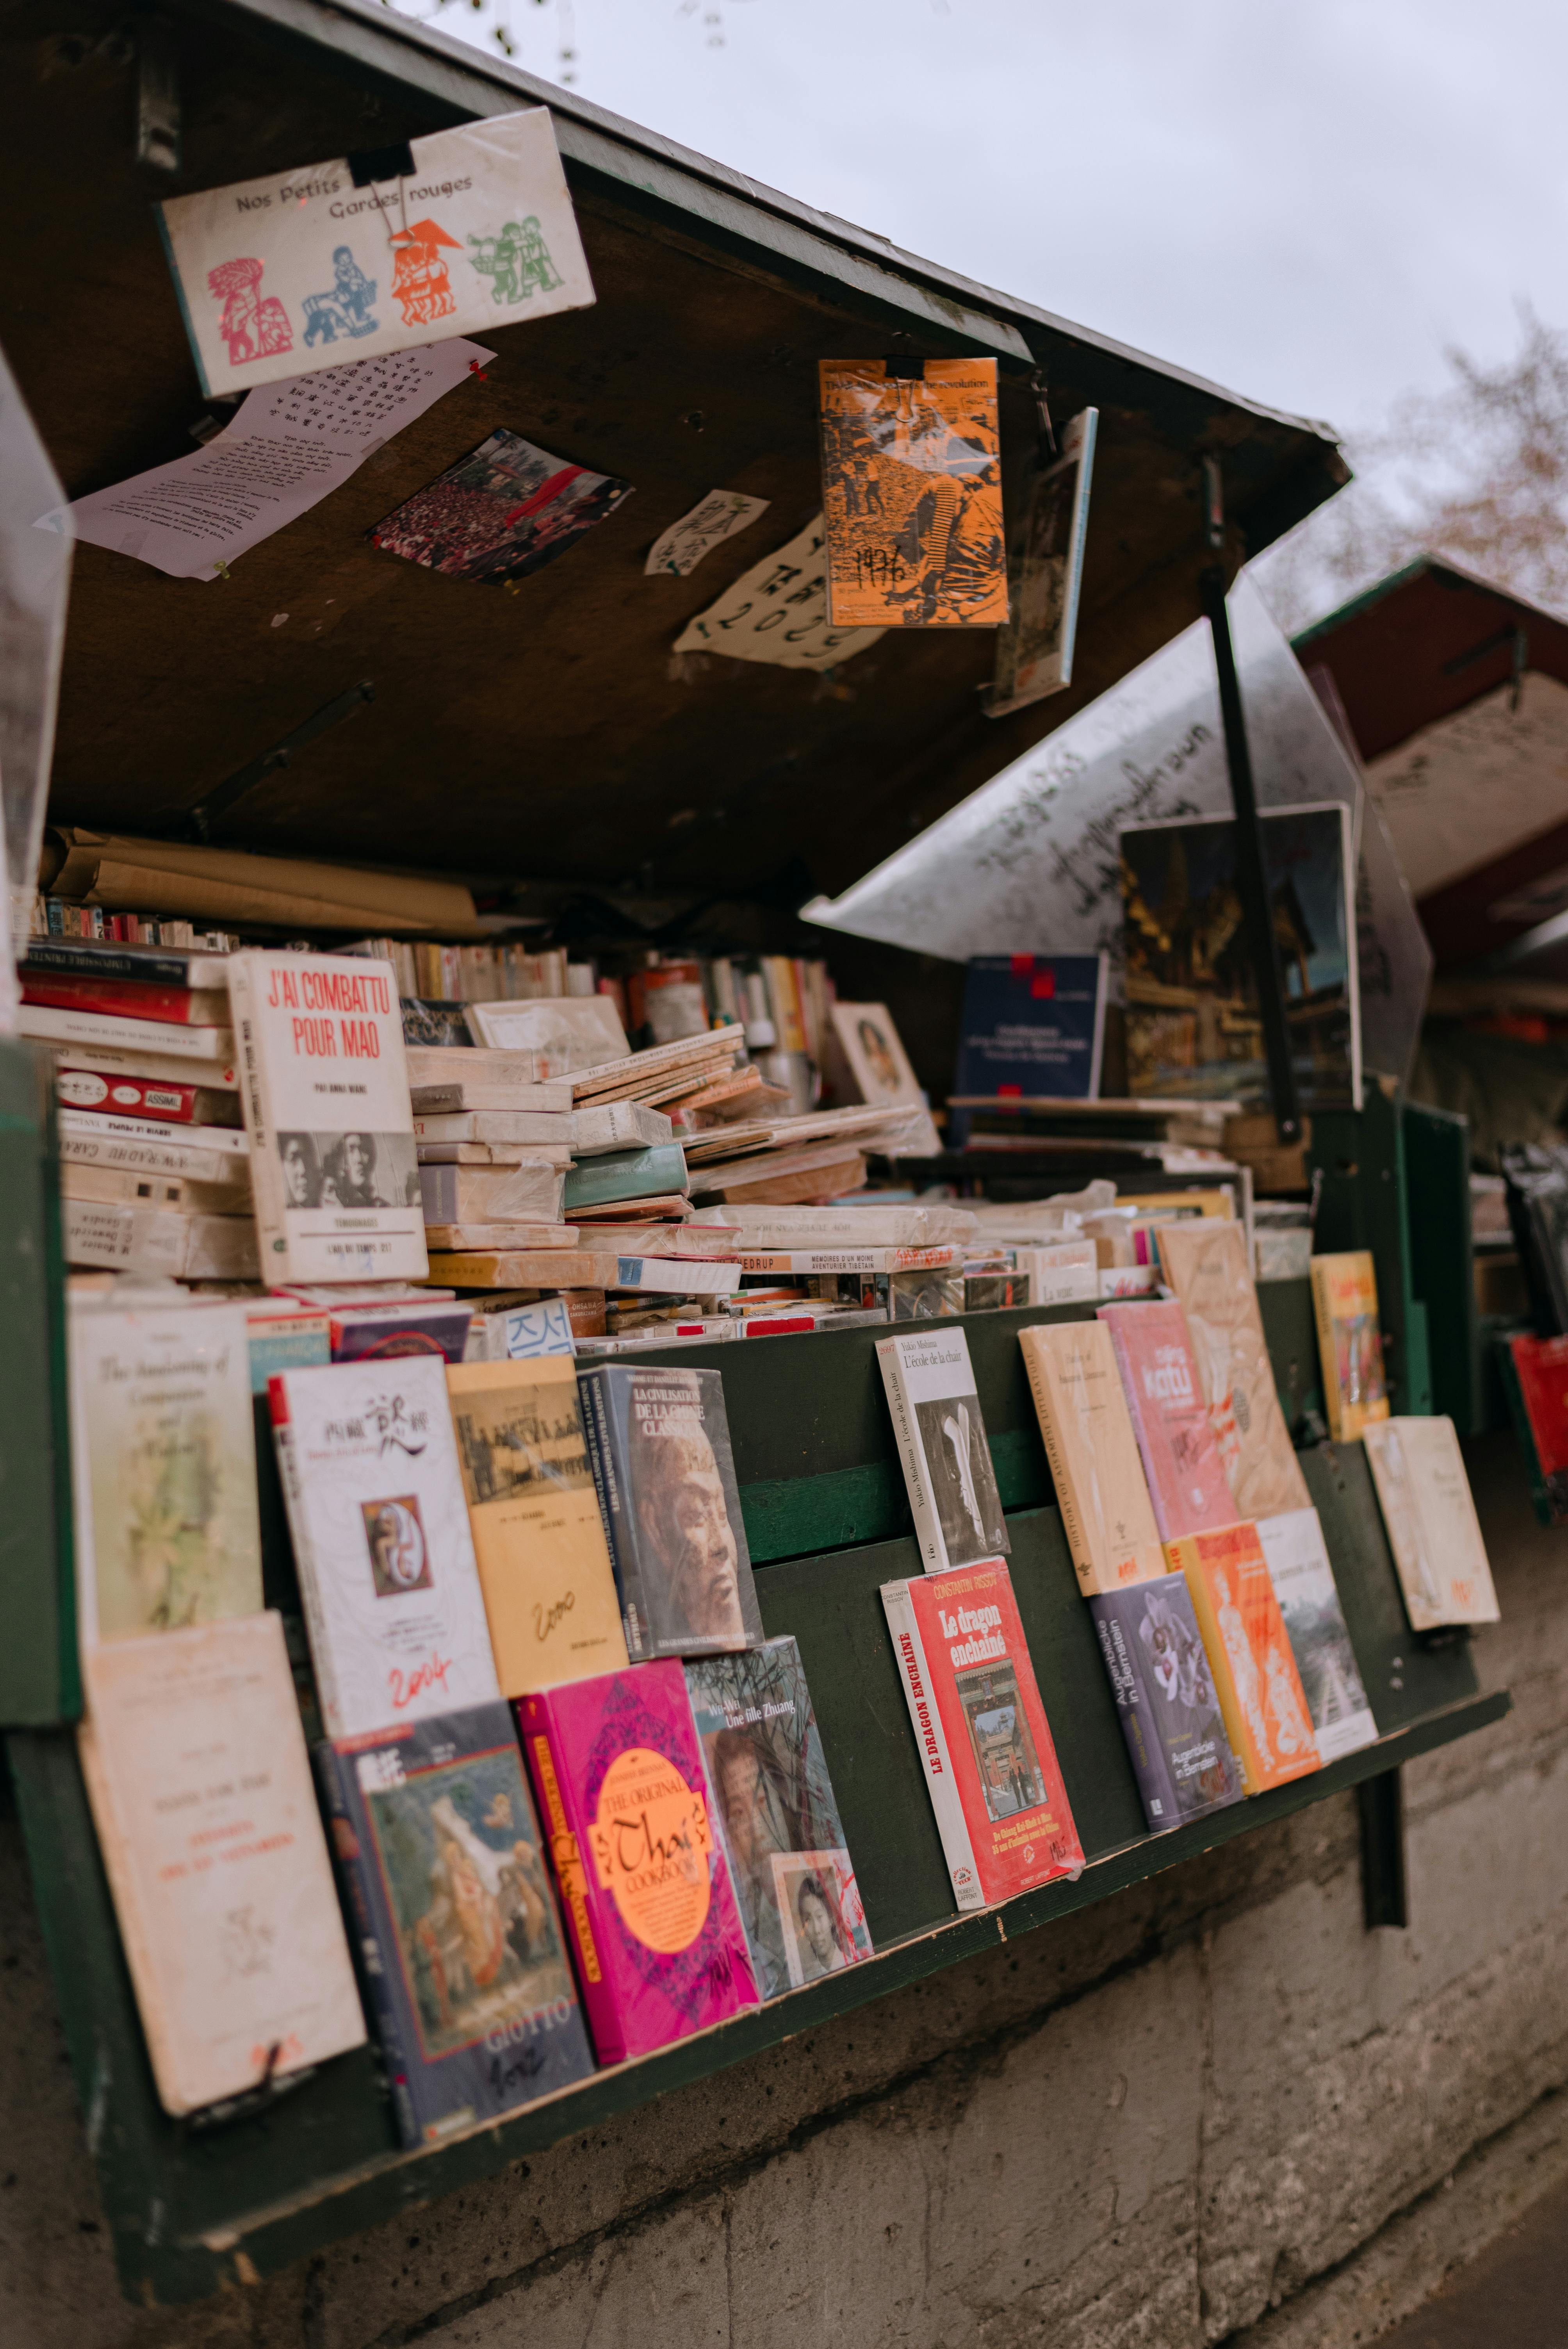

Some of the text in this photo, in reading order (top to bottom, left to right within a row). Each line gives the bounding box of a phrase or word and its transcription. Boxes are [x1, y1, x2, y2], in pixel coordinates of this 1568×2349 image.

[236, 179, 341, 212] Nos Petits
[328, 177, 473, 219] Gardes rouges
[939, 378, 989, 389] revolution
[268, 969, 390, 1014] J'AI COMBATTU
[292, 1016, 337, 1057] POUR
[341, 1019, 380, 1059] MAO
[147, 1093, 178, 1108] ASSIMIL
[107, 1122, 134, 1133] PEUPLE
[135, 1126, 144, 1134] LE
[146, 1127, 172, 1137] SERVIR
[572, 1302, 597, 1311] OHSAWA
[879, 1344, 894, 1355] 2697
[901, 1339, 937, 1351] Yukio Mishima
[903, 1349, 962, 1368] L'école de la chair
[890, 1372, 898, 1389] chair
[1028, 1354, 1048, 1420] LITERATURE
[633, 1388, 700, 1402] LA CIVILISATION
[636, 1403, 653, 1420] DE
[653, 1403, 668, 1420] LA
[897, 1404, 904, 1413] de
[900, 1414, 911, 1442] L'école
[1045, 1425, 1063, 1477] ASSAMESE
[908, 1449, 919, 1482] Mishima
[915, 1484, 925, 1508] Yukio
[1063, 1501, 1081, 1547] HISTORY
[881, 1590, 909, 1600] CONSTANTIN
[934, 1572, 998, 1600] CONSTANTIN RISSOV
[887, 1596, 904, 1604] RISSOV
[938, 1605, 1002, 1639] Le dragon
[1098, 1619, 1128, 1706] Augenblicke
[1109, 1619, 1135, 1688] Bernstein
[387, 1650, 453, 1709] 2004
[898, 1632, 943, 1775] LE DRAGON ENCHAÎNÉ
[1128, 1689, 1139, 1703] in
[725, 1700, 796, 1728] Une fille Zhuang
[1171, 1740, 1216, 1765] Augenblicke
[1174, 1756, 1219, 1779] in Bernstein
[604, 1776, 686, 1813] THE ORIGINAL
[992, 1844, 1000, 1855] 35
[1000, 1843, 1009, 1852] ans
[1045, 1822, 1060, 1834] Chine
[993, 1832, 1001, 1842] De
[1000, 1827, 1018, 1839] Chiang
[1041, 1813, 1052, 1823] Mao
[613, 1810, 692, 1872] Thai
[958, 1886, 975, 1895] ROBERT
[958, 1893, 977, 1902] LAFFONT
[483, 1995, 571, 2053] GIOTTO
